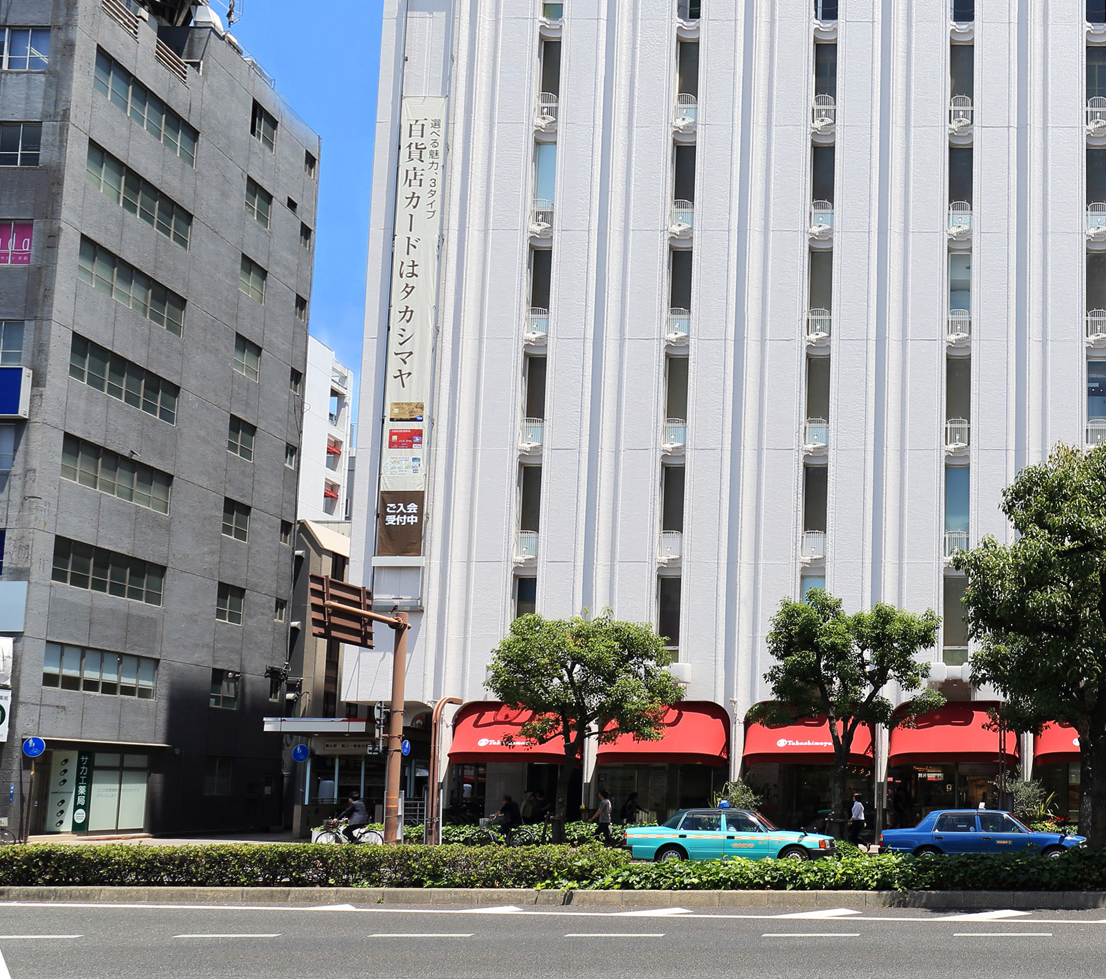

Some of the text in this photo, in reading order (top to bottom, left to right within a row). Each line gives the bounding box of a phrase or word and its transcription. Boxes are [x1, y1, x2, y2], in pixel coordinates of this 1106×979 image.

[426, 118, 442, 220] 選べる魅力、3タイプ
[0, 232, 30, 250] da
[392, 117, 428, 389] 百貨店カードはタカシマヤ
[386, 503, 418, 513] ご入会
[385, 514, 418, 526] 受付中
[787, 739, 833, 747] Takashimaya
[76, 755, 89, 806] サカエ薬局
